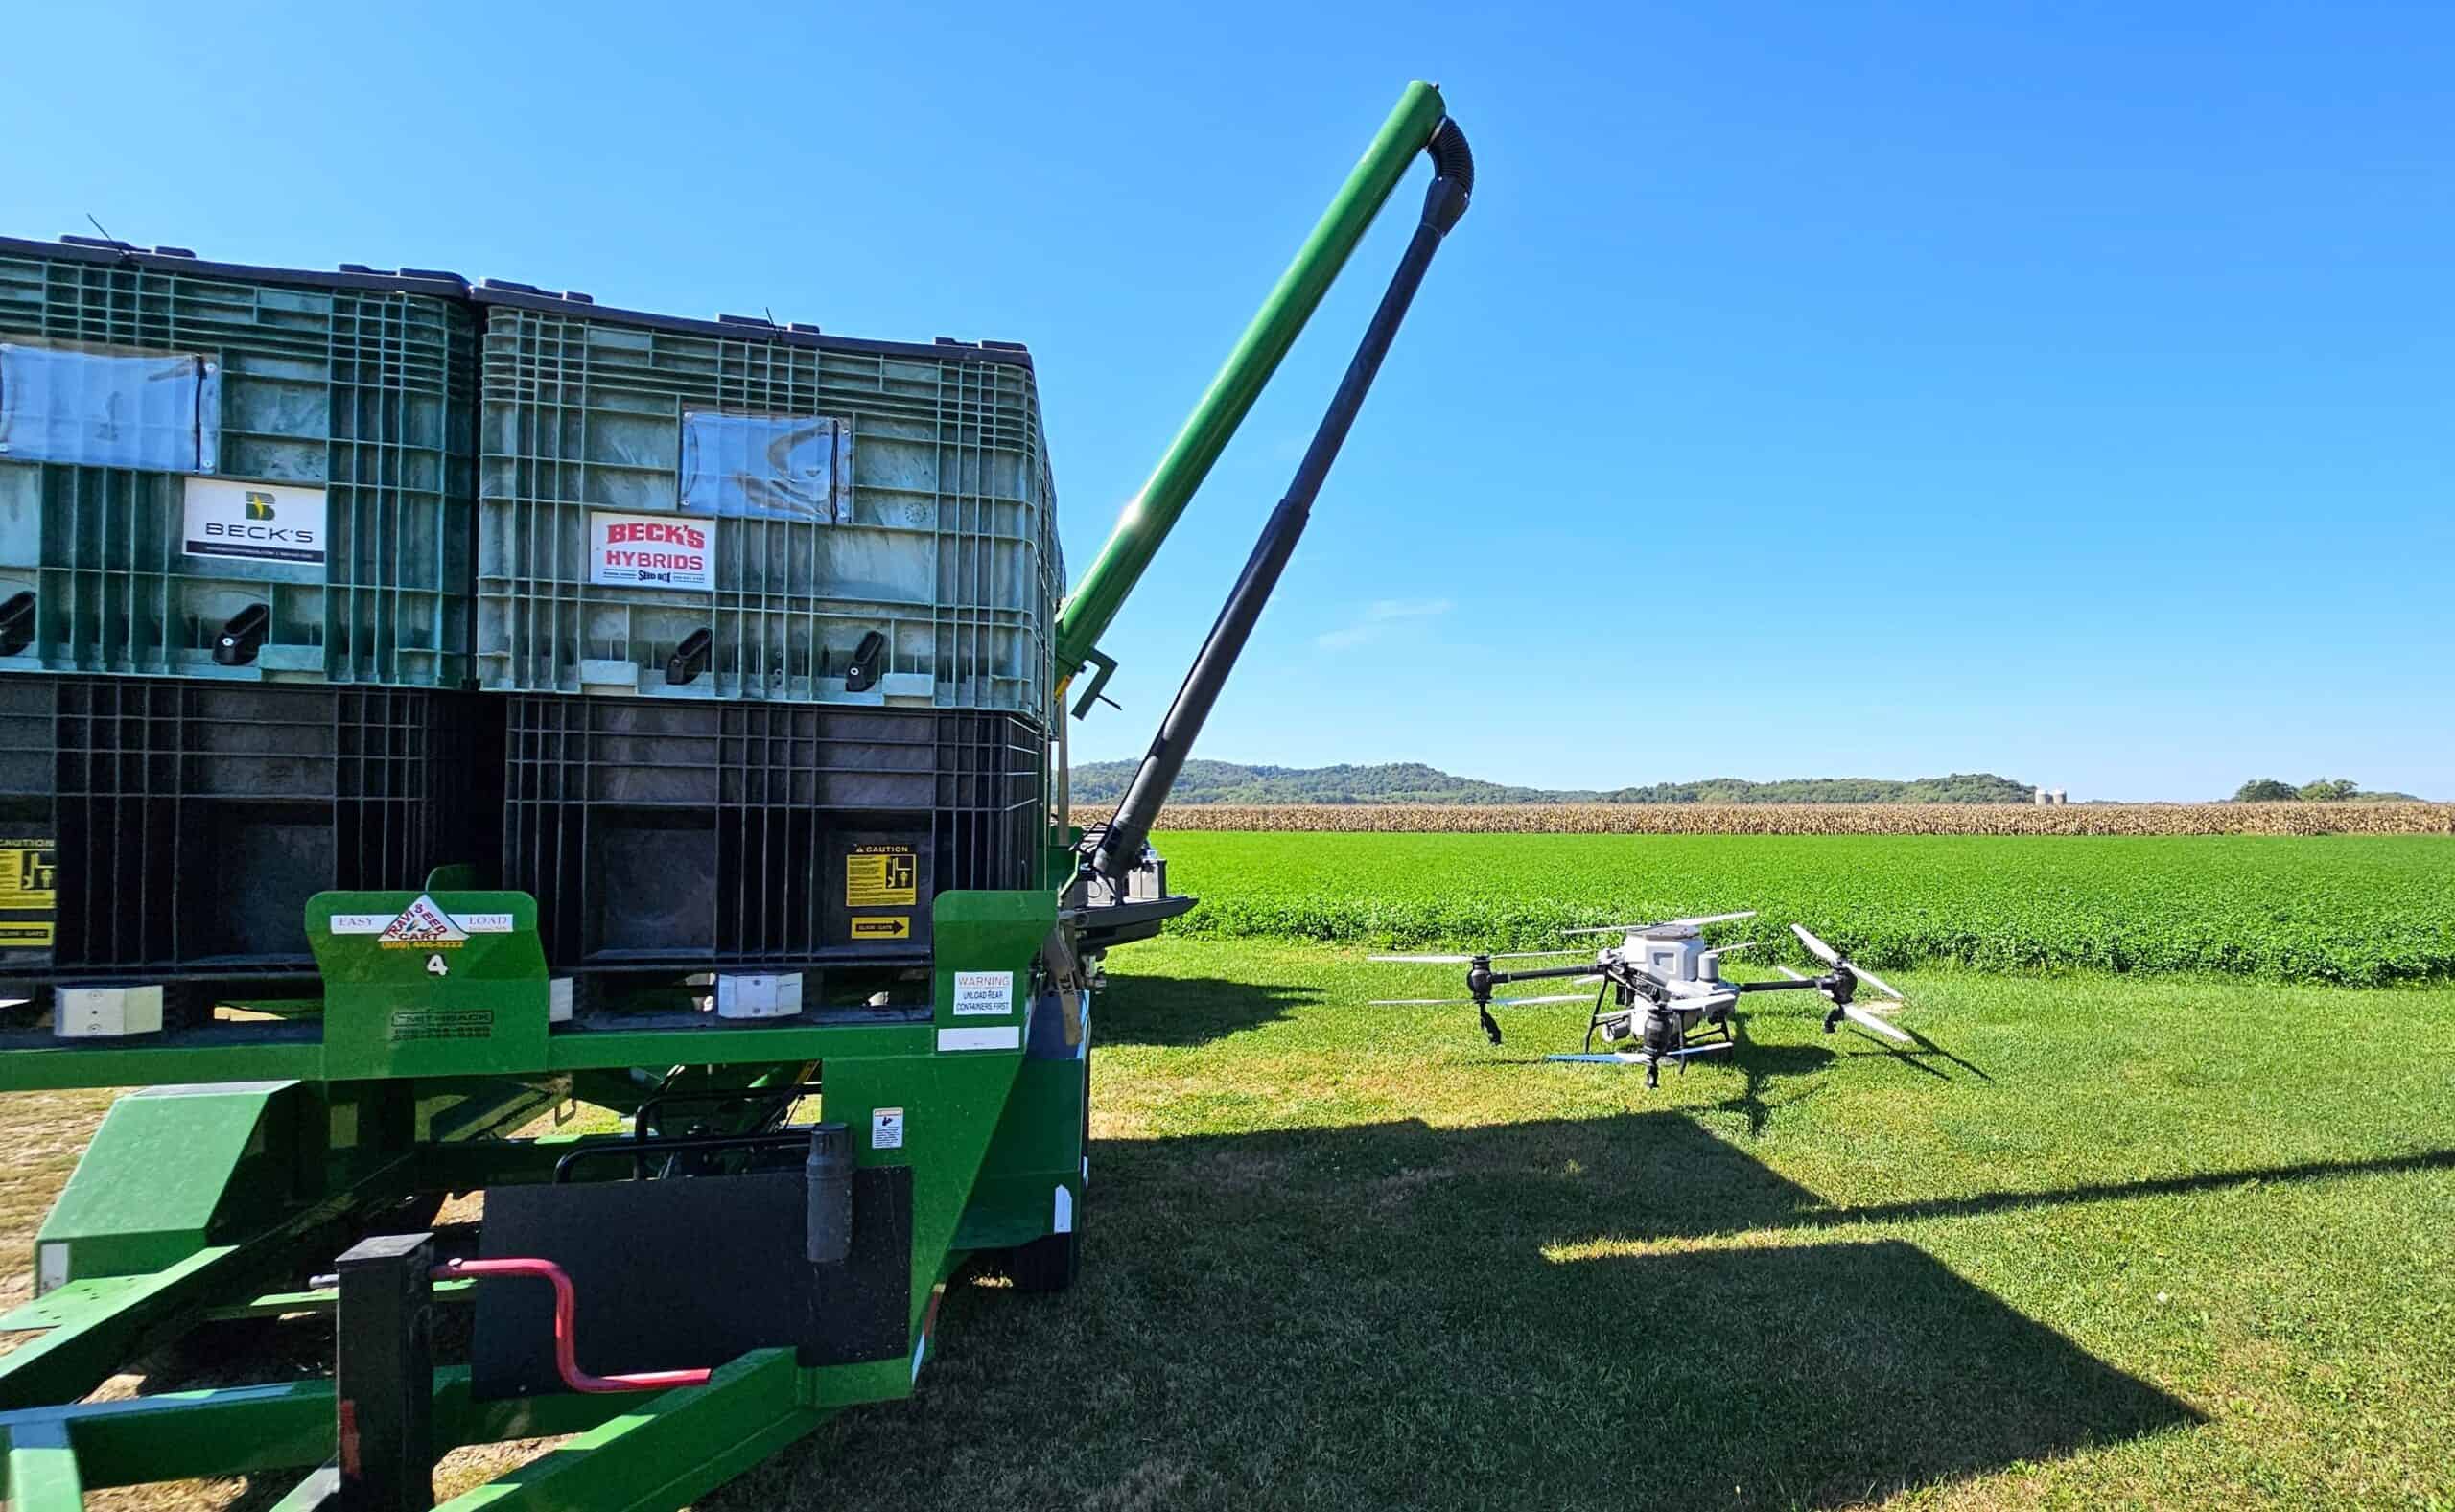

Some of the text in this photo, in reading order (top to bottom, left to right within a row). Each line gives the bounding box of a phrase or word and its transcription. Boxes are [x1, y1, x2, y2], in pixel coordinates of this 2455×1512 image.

[205, 523, 314, 544] BECK'S
[606, 523, 705, 549] BECK'S
[605, 550, 703, 570] HYBRIDS
[339, 917, 374, 927] EASY
[468, 915, 508, 925] LOAD
[426, 954, 449, 976] 4
[958, 975, 1010, 987] WARNING
[963, 990, 987, 1000] UNLOAD
[956, 1002, 993, 1012] CONTAINERS
